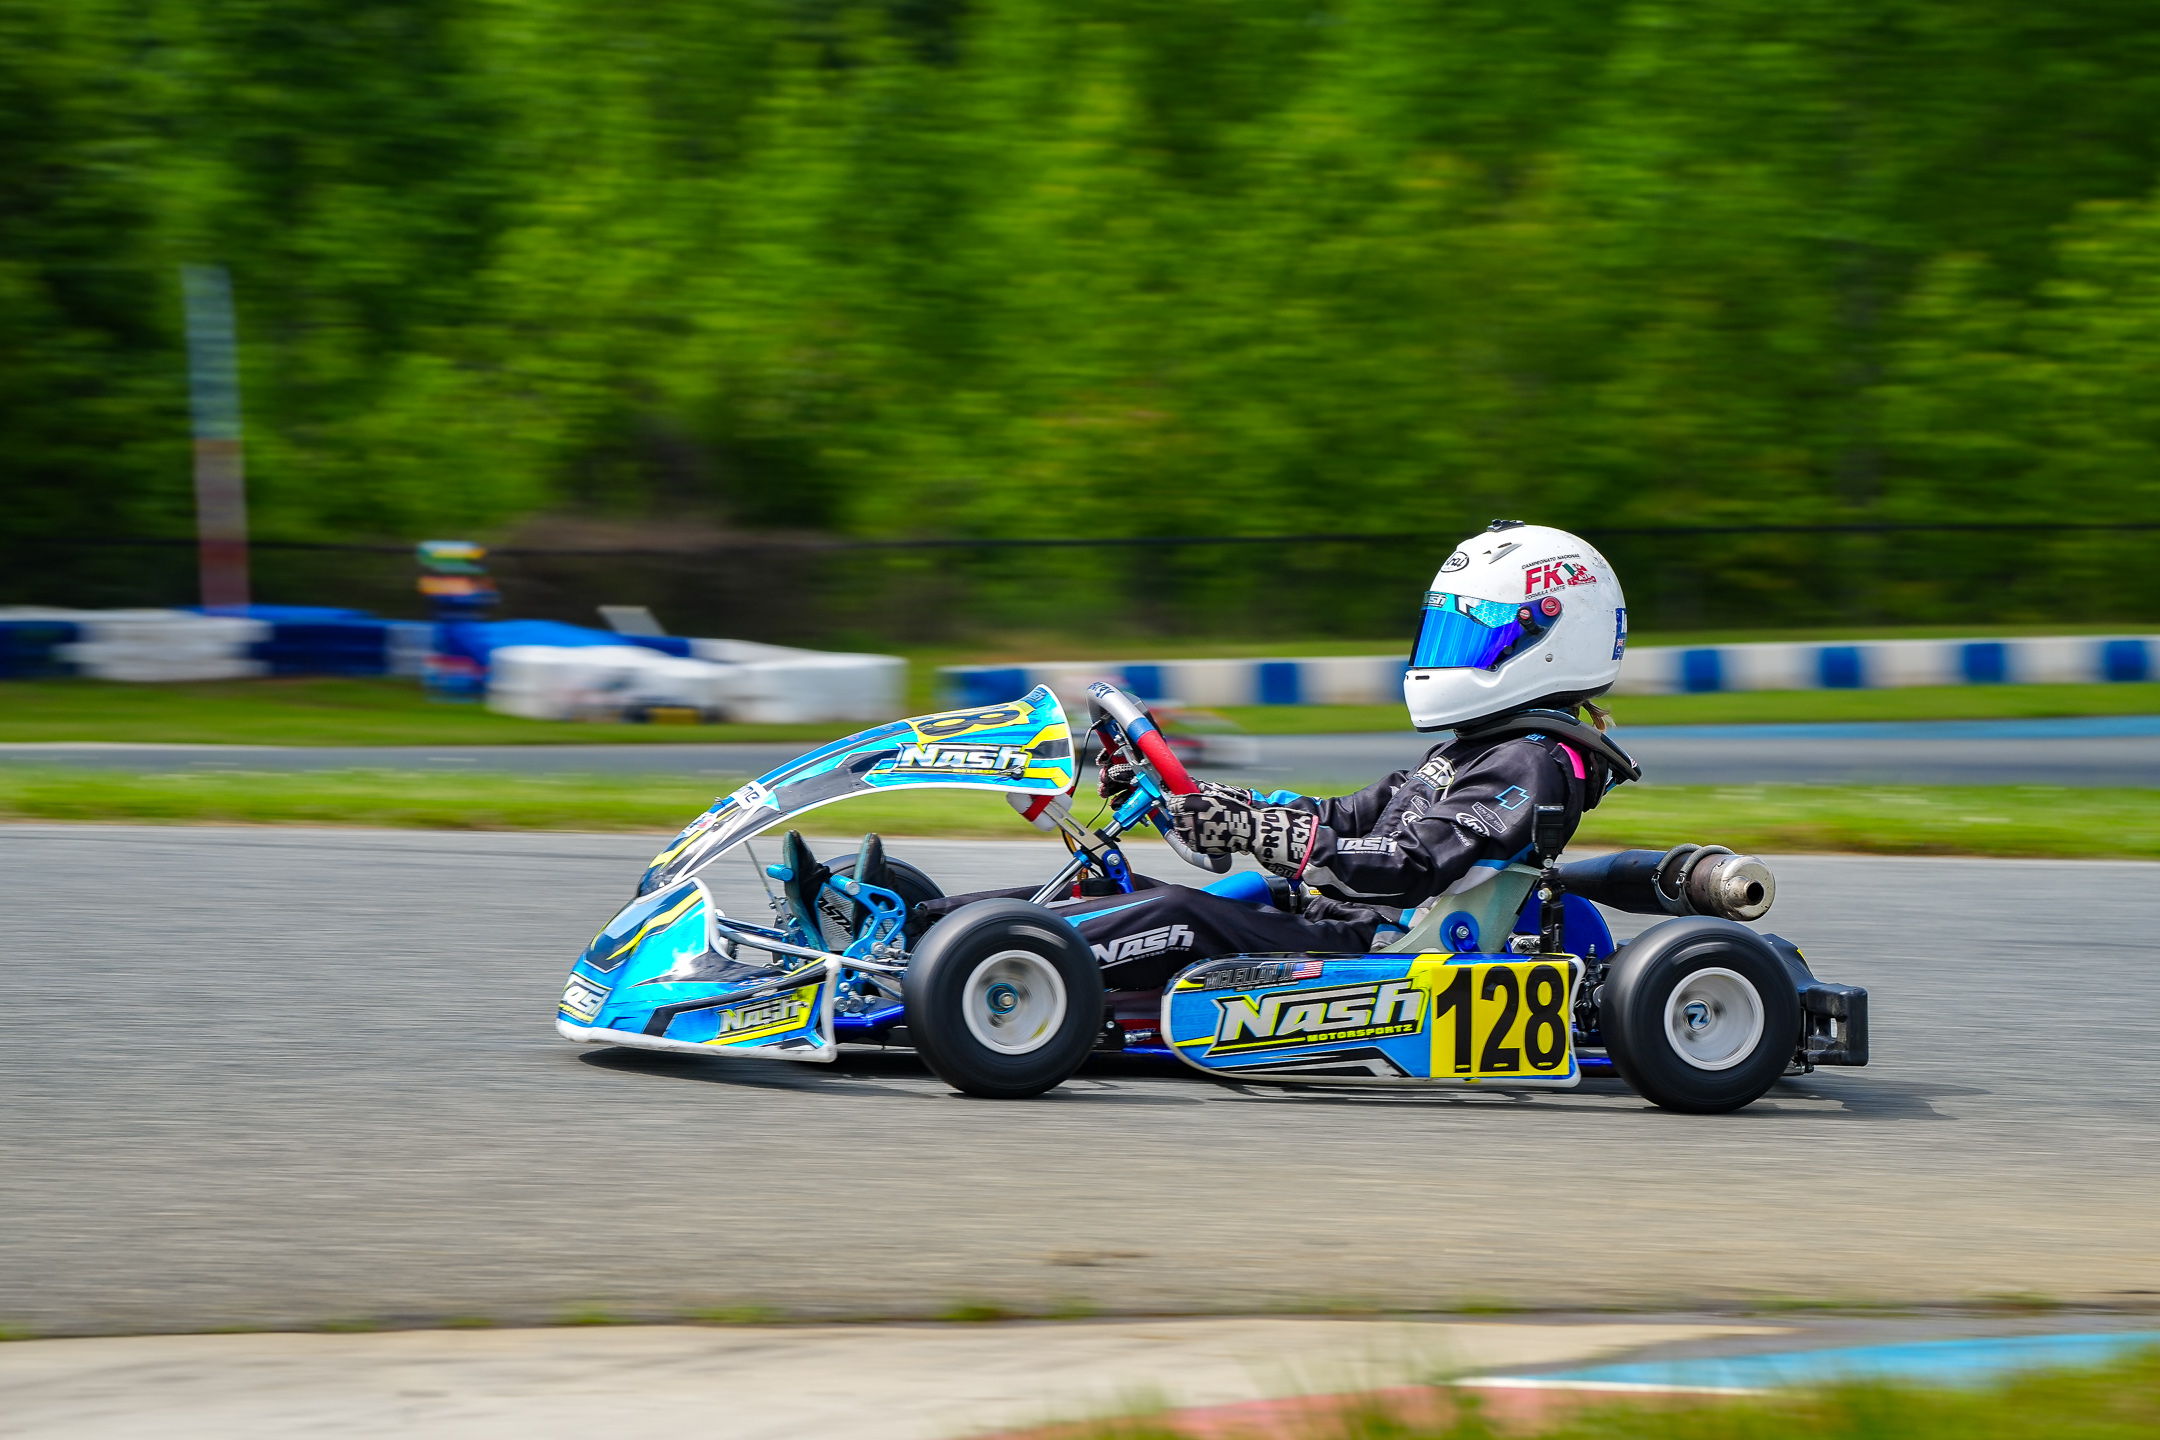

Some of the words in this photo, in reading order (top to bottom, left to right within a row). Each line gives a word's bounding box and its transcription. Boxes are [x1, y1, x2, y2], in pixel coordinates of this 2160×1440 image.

[1525, 561, 1564, 595] FK
[1525, 589, 1548, 600] FORMULA
[1550, 585, 1566, 593] KARTS
[1219, 981, 1426, 1042] Nash
[1436, 964, 1567, 1073] 128
[1306, 1023, 1414, 1043] MOTORSPORTZ
